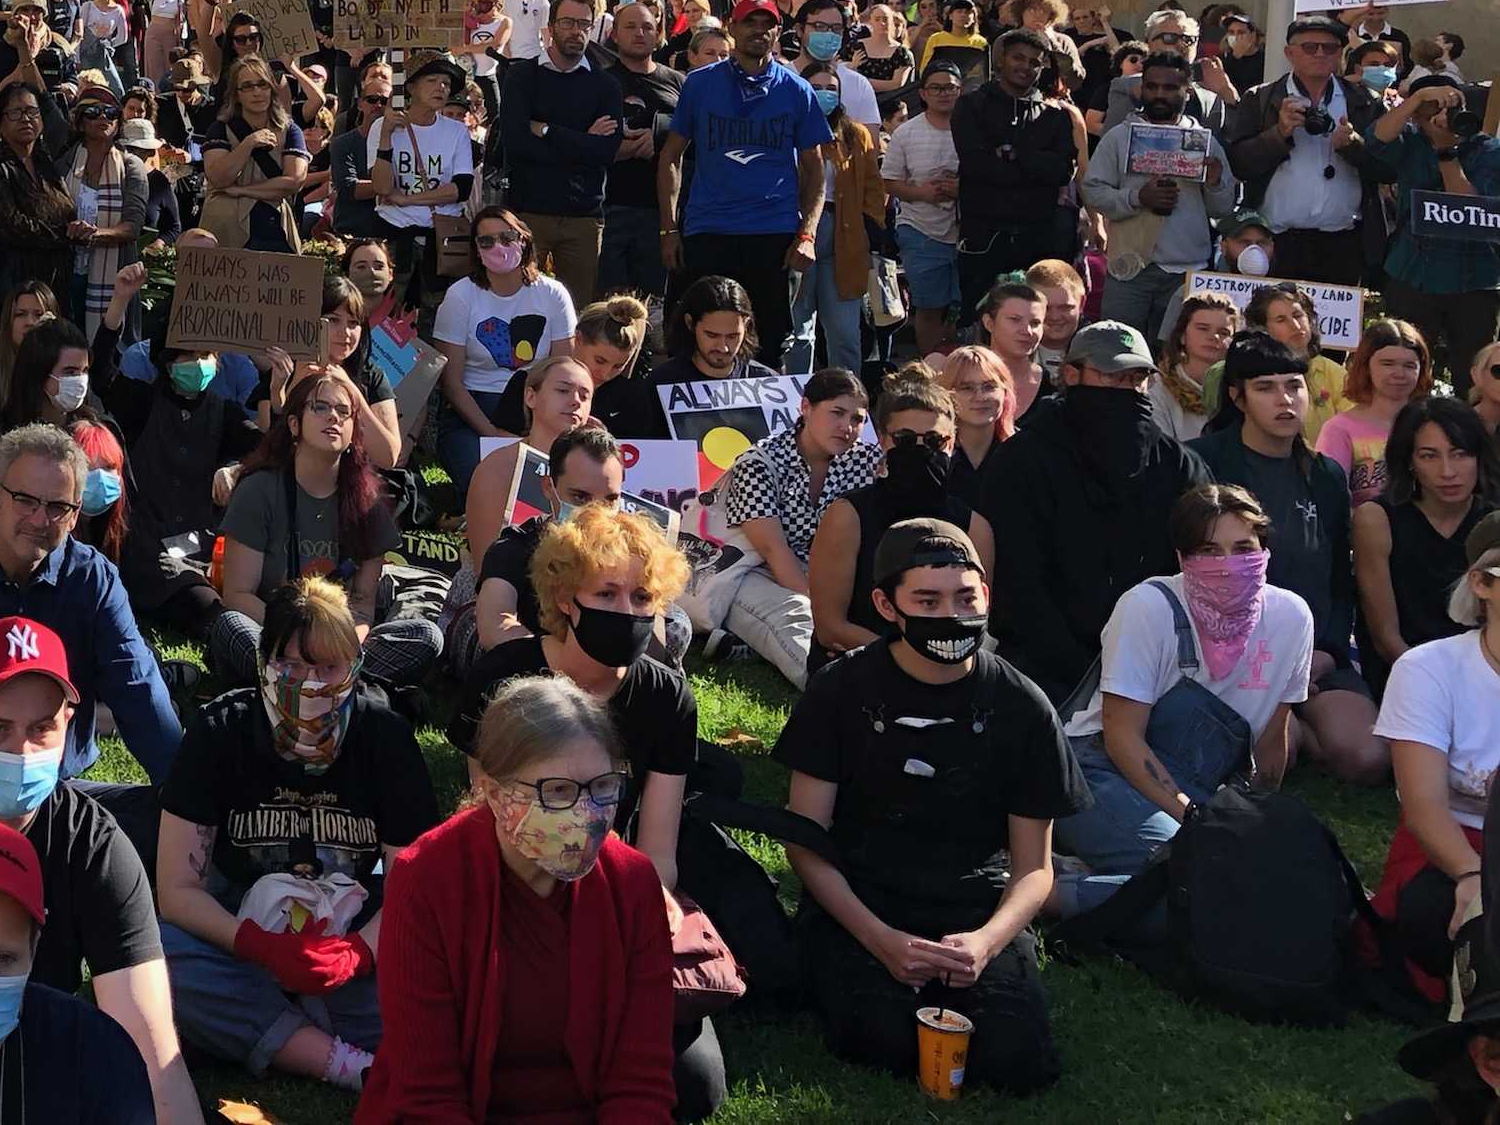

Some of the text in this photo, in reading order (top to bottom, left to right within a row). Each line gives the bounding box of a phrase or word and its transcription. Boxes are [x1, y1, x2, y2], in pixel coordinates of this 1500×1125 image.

[182, 251, 290, 284] ALWAYS WAS
[185, 282, 307, 306] ALWAYS WILL BE
[1321, 290, 1353, 302] LAND
[171, 305, 270, 342] ABORIGINAL
[669, 377, 788, 411] ALWAYS
[396, 533, 459, 562] TAND
[228, 808, 300, 839] CHAMBER
